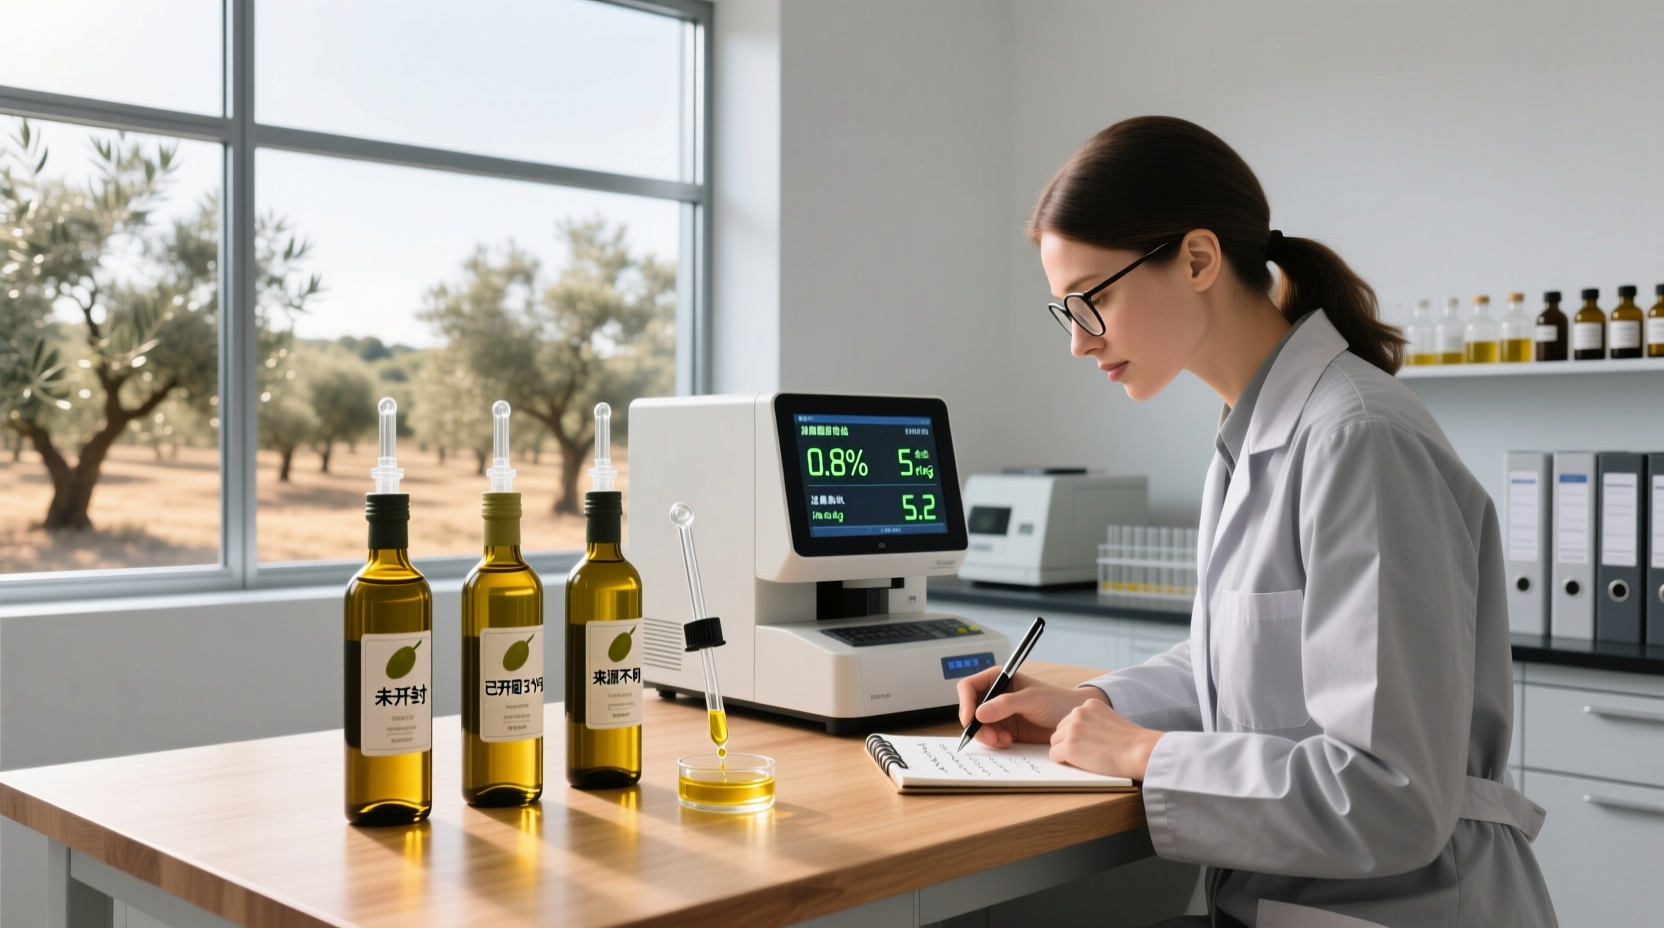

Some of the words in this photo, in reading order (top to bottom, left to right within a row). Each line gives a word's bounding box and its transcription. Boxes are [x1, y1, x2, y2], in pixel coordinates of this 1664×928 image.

[807, 447, 869, 477] 0.8%
[898, 448, 914, 476] 5
[902, 494, 937, 521] 5.2
